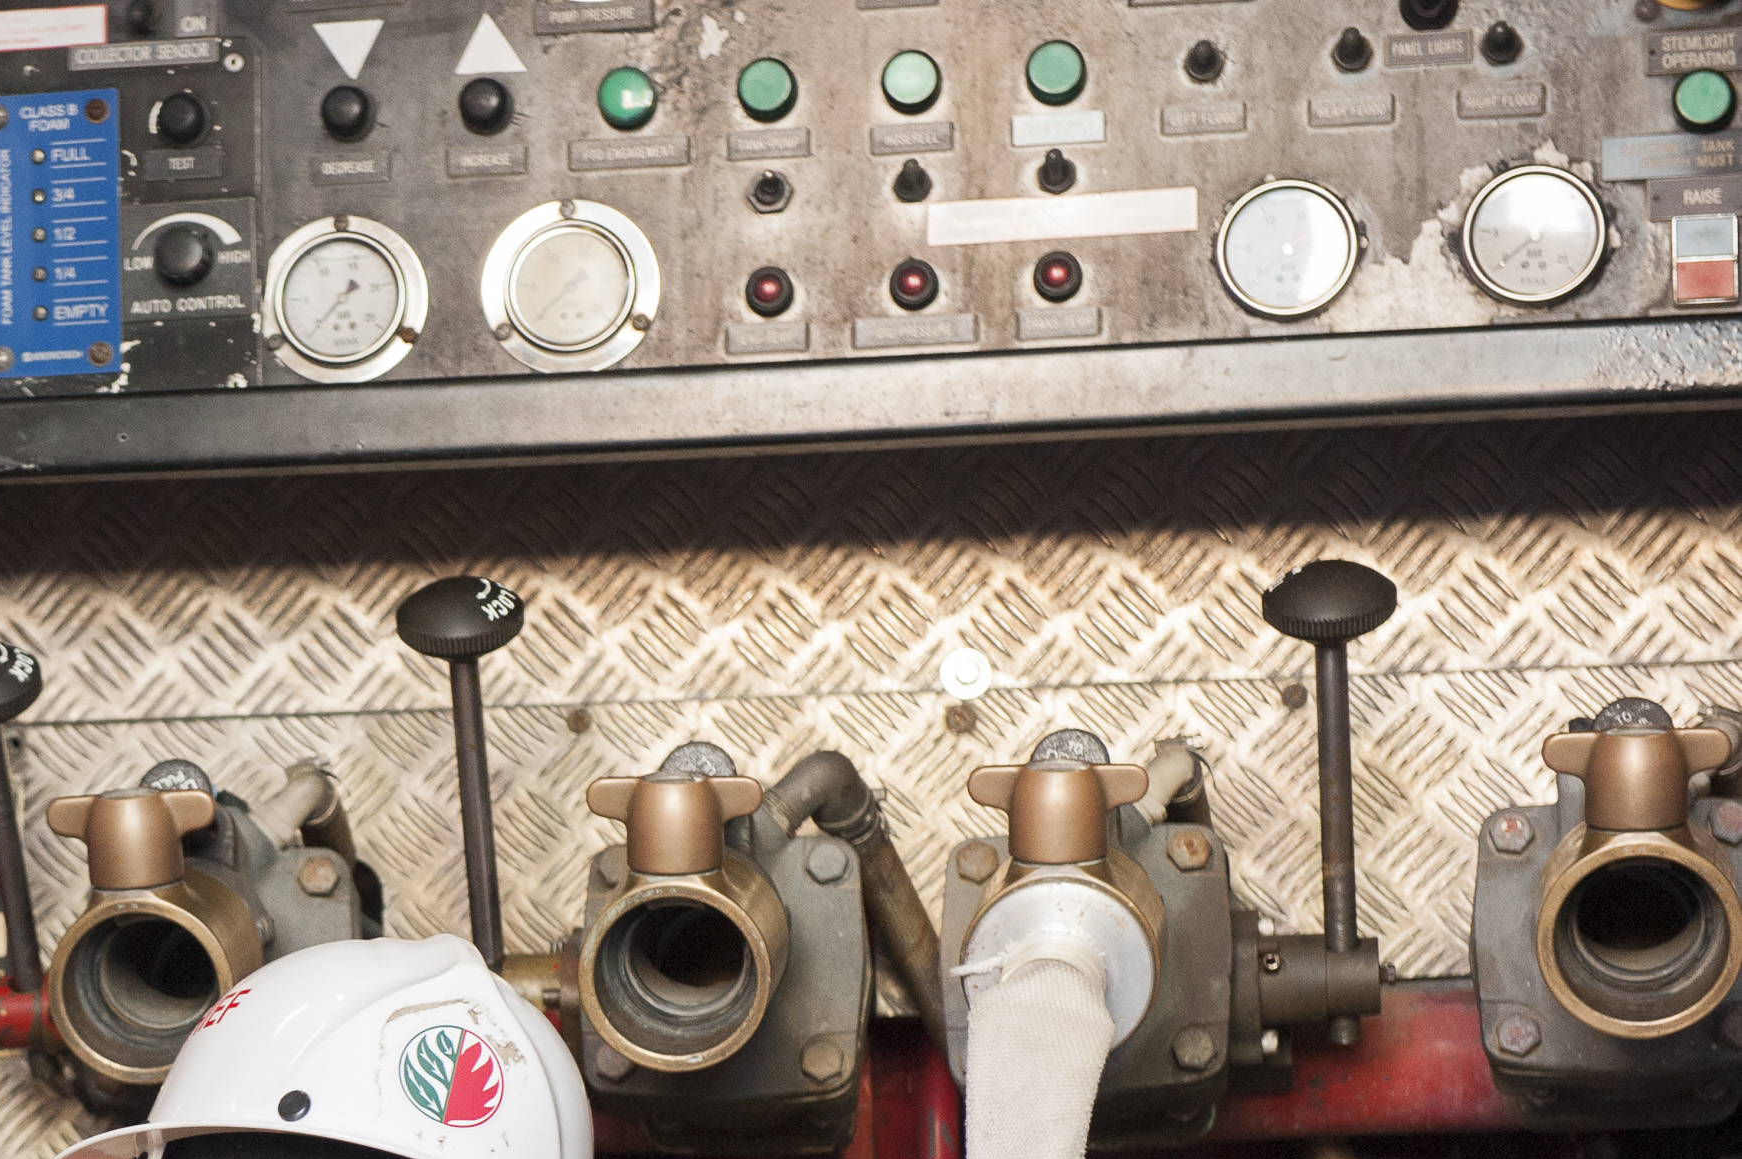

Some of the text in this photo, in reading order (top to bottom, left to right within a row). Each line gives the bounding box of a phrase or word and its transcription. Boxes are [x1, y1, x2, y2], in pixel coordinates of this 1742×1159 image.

[181, 15, 207, 33] ON
[76, 42, 210, 65] COLLECTOR SENSOR
[1391, 38, 1464, 57] PANEL LIGHTS
[1661, 51, 1737, 69] OPERATING
[19, 104, 67, 119] CLASS
[27, 117, 71, 132] FOAM
[1701, 139, 1735, 152] TANK
[50, 147, 92, 162] FULL
[459, 153, 512, 168] INCREASE
[168, 156, 195, 170] TEST
[321, 159, 377, 175] DECREASE
[51, 187, 75, 202] 3/4
[1682, 187, 1723, 205] RAISE
[0, 216, 13, 254] LEVEL
[53, 226, 77, 241] 1/2
[123, 256, 154, 271] LOW
[217, 250, 252, 265] HIGH
[0, 256, 13, 287] TANK
[54, 266, 77, 280] 1/4
[0, 289, 13, 325] FOAM
[53, 303, 109, 321] EMPTY
[130, 294, 246, 315] AUTO CONTROL
